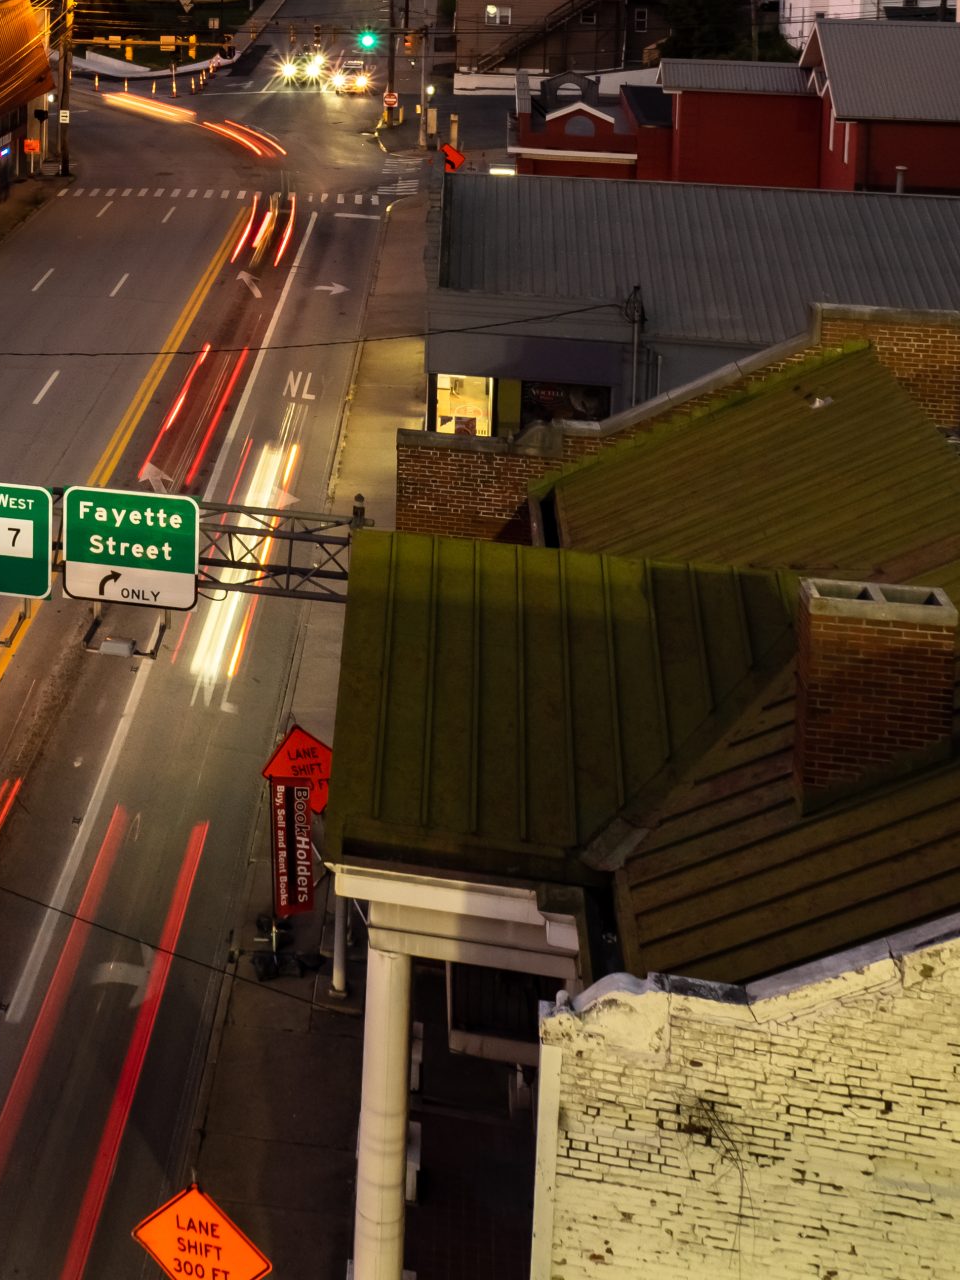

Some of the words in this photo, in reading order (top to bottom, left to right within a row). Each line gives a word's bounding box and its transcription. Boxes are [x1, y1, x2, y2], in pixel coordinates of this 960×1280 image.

[79, 501, 183, 529] Fayette
[7, 527, 21, 547] 7
[89, 535, 172, 560] Street
[120, 587, 161, 602] ONLY
[287, 746, 319, 761] LANE
[290, 762, 323, 777] SHIFT
[275, 785, 285, 806] Buy,
[277, 809, 286, 828] Sell
[278, 830, 286, 848] and
[294, 786, 310, 902] BookHolders
[278, 850, 287, 873] Rent
[279, 875, 288, 906] Books
[176, 1214, 220, 1239] LANE
[177, 1237, 222, 1261] SHIFT
[173, 1258, 205, 1279] 300
[212, 1267, 230, 1280] FT
